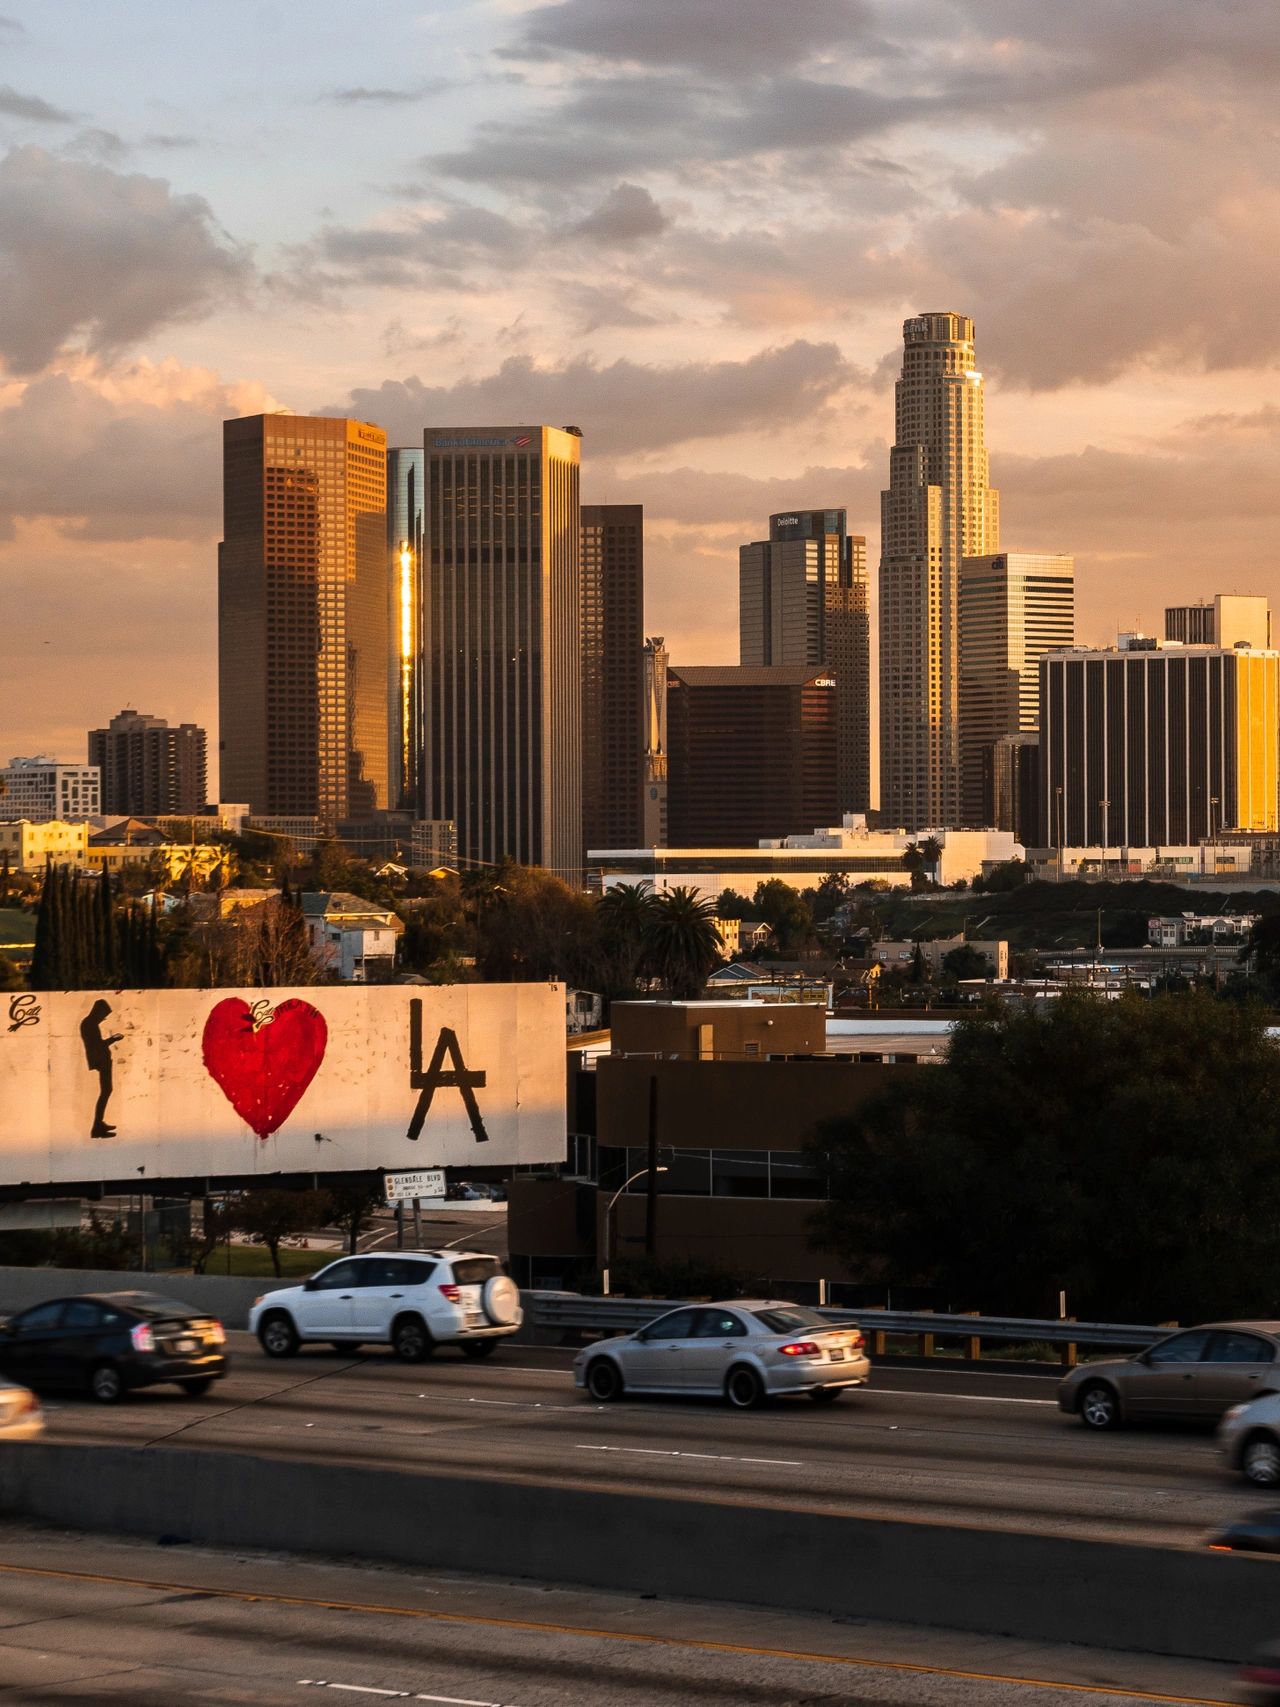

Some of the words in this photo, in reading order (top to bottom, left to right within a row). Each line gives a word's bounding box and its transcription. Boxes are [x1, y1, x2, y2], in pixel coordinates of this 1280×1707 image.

[777, 517, 799, 527] Deloitte
[815, 679, 836, 687] CBRE
[406, 998, 489, 1142] LA
[394, 1175, 423, 1184] GLENDALE
[427, 1174, 441, 1182] BLVD
